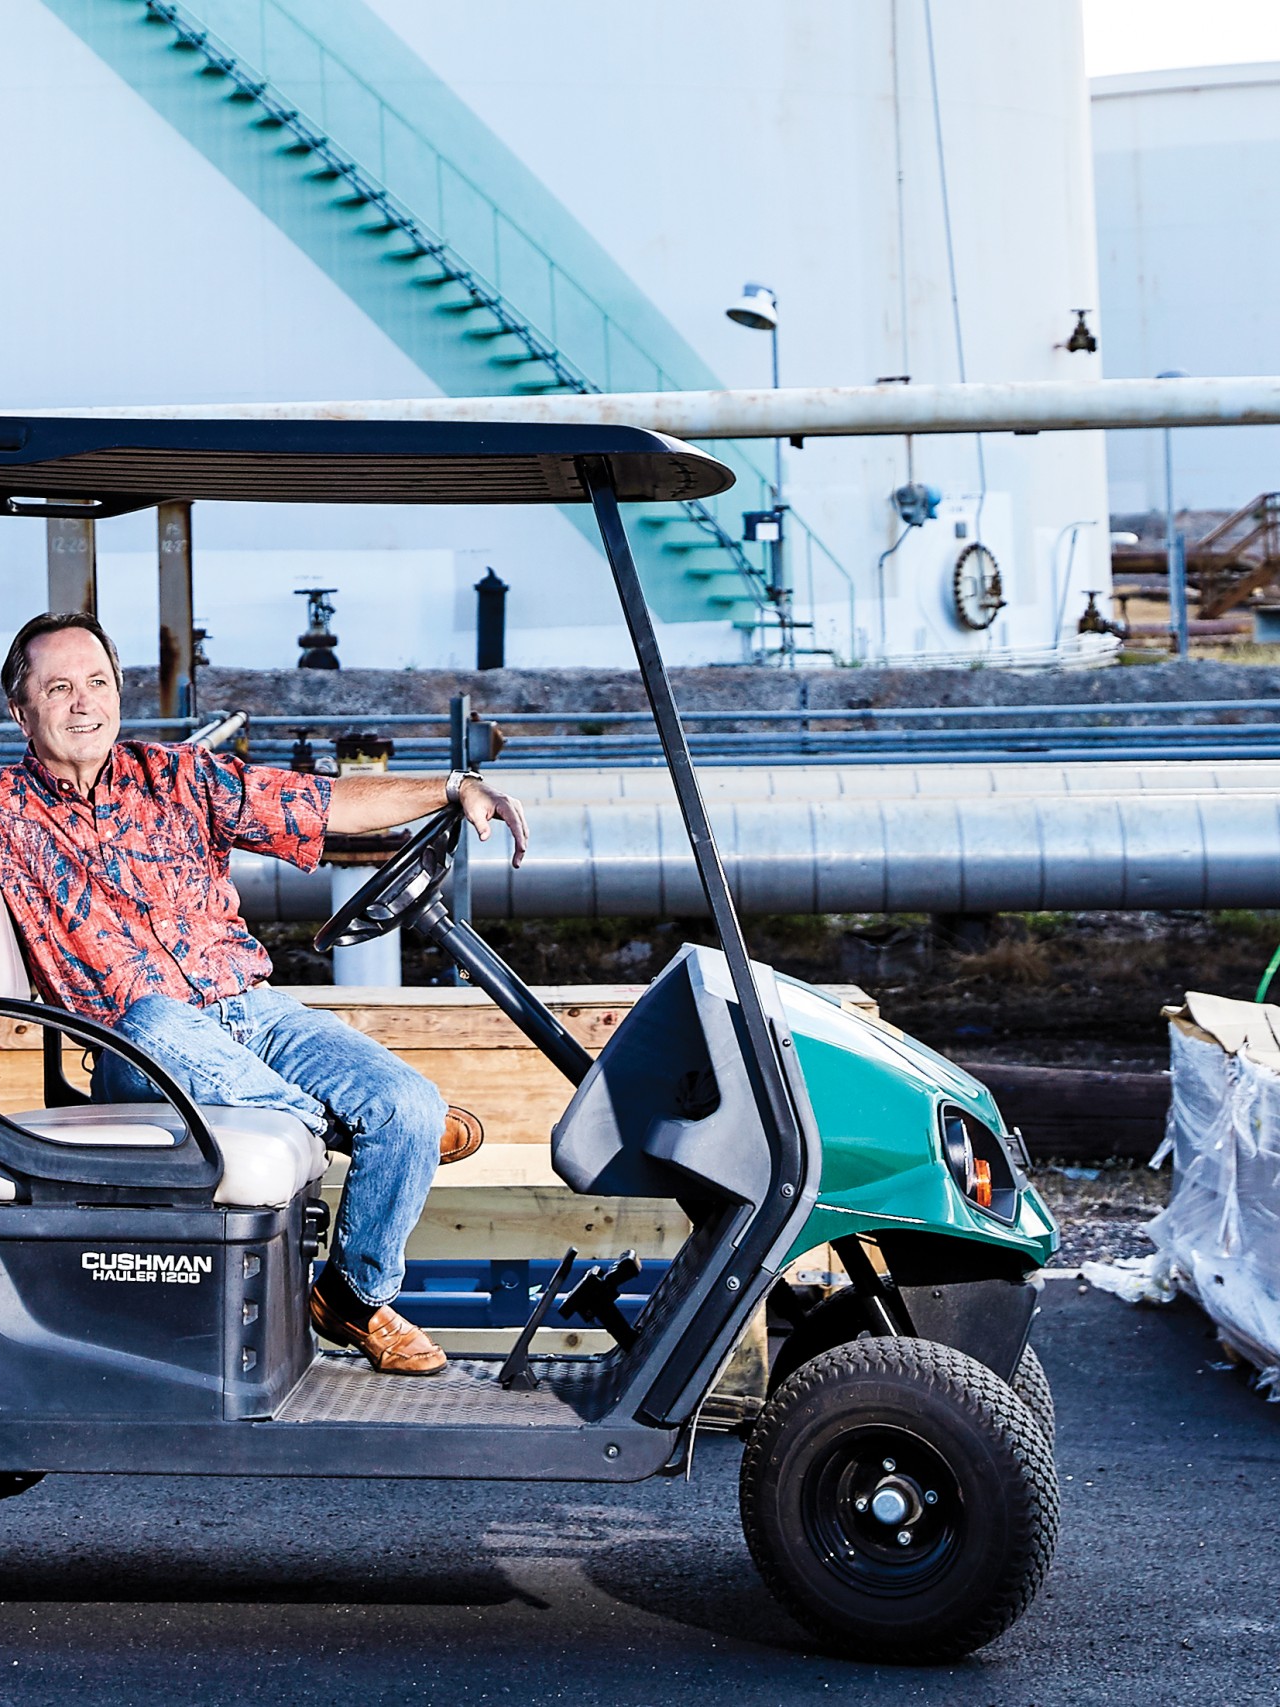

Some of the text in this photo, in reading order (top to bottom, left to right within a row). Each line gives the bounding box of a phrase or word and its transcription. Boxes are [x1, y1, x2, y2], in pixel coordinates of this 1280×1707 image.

[81, 1252, 212, 1273] CUSHMAN
[92, 1270, 201, 1284] HAULER 1200
